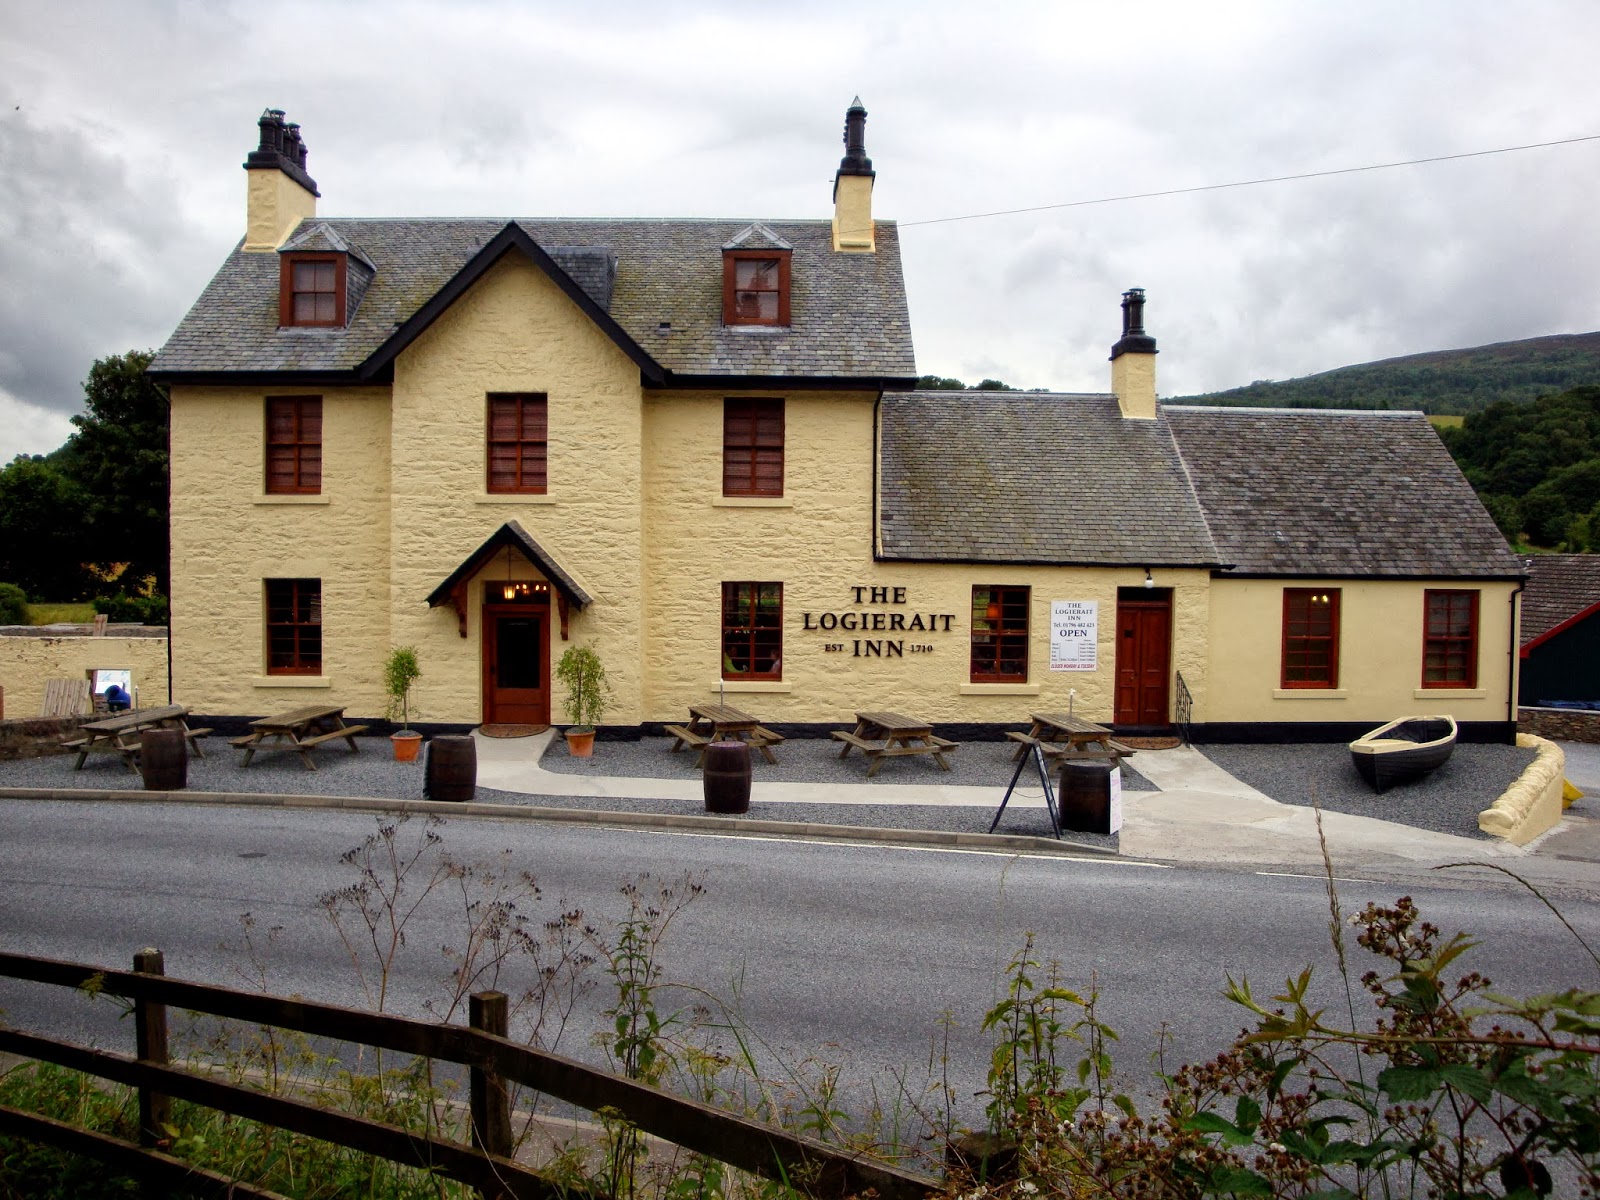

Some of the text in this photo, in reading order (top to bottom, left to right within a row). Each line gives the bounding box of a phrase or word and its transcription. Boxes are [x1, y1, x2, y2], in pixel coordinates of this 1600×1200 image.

[850, 586, 907, 604] THE
[802, 612, 956, 631] LOGIERAIT
[1059, 629, 1087, 637] OPEN
[824, 639, 933, 657] EST INN 1710
